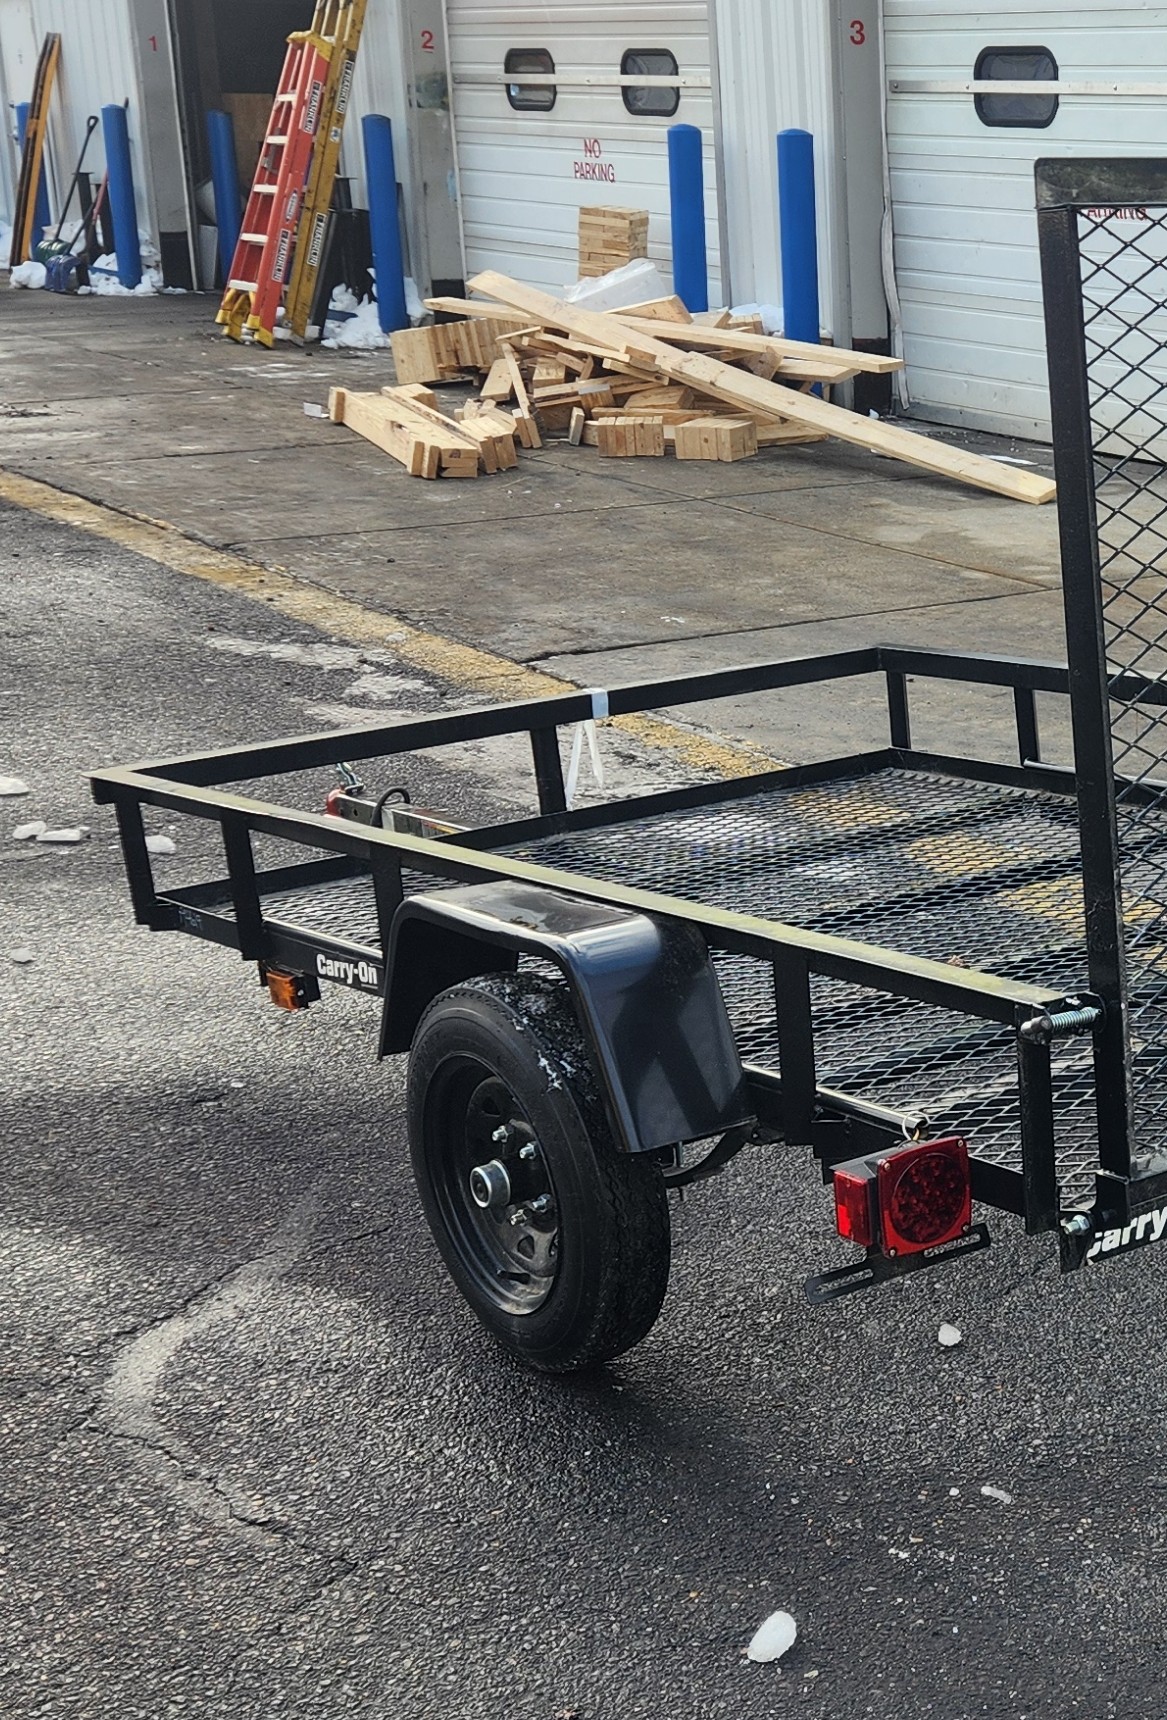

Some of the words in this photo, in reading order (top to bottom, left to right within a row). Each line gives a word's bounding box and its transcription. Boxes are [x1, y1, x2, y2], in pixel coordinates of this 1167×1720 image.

[148, 36, 157, 51] 1
[421, 30, 433, 49] 2
[850, 20, 865, 45] 3
[337, 69, 352, 113] FRANKLIN
[304, 88, 320, 132] FRANKLIN
[584, 138, 601, 158] NO
[573, 162, 615, 182] PARKING
[309, 222, 324, 266] FRANKLIN
[274, 237, 289, 280] FRANKLIN
[317, 954, 377, 984] Carry-On
